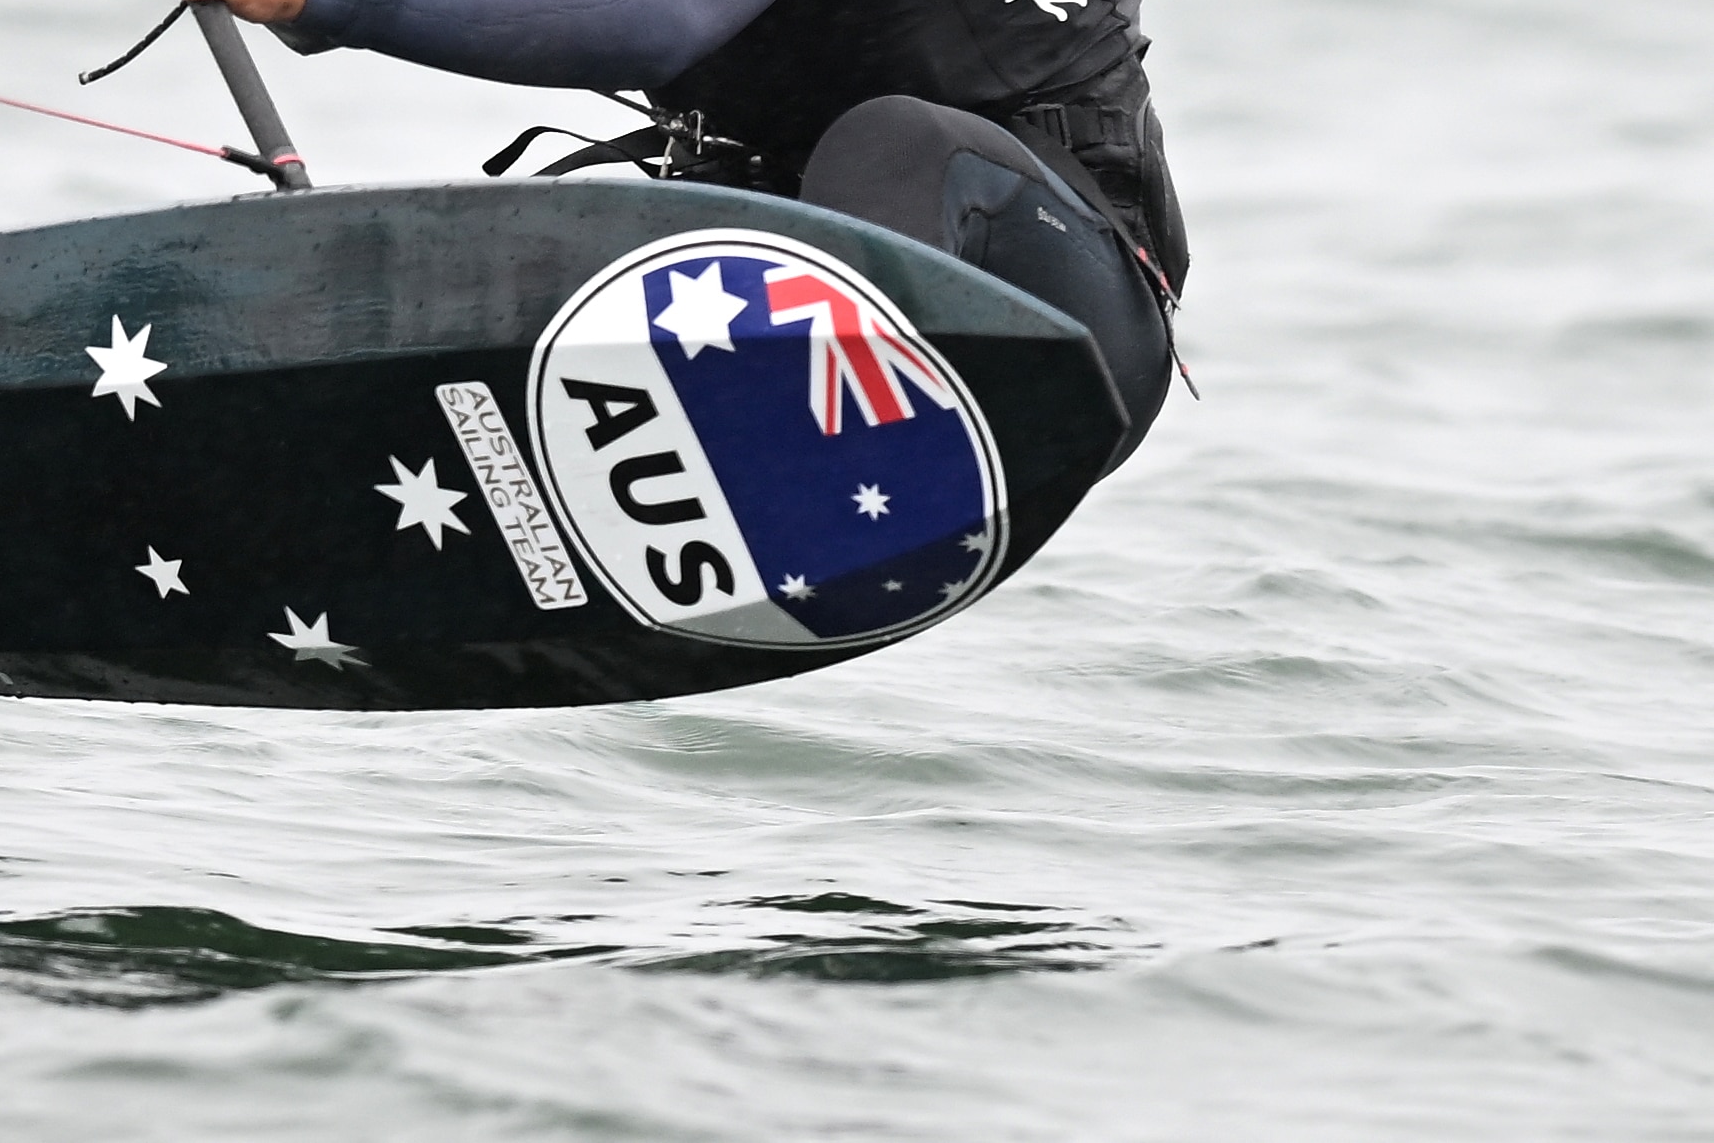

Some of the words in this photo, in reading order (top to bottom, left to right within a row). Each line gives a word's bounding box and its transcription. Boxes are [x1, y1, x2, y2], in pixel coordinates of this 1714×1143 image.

[441, 386, 512, 509] SAILING
[504, 516, 557, 604] TEAM
[465, 388, 583, 602] AUSTRALIAN
[560, 377, 735, 607] AUS
